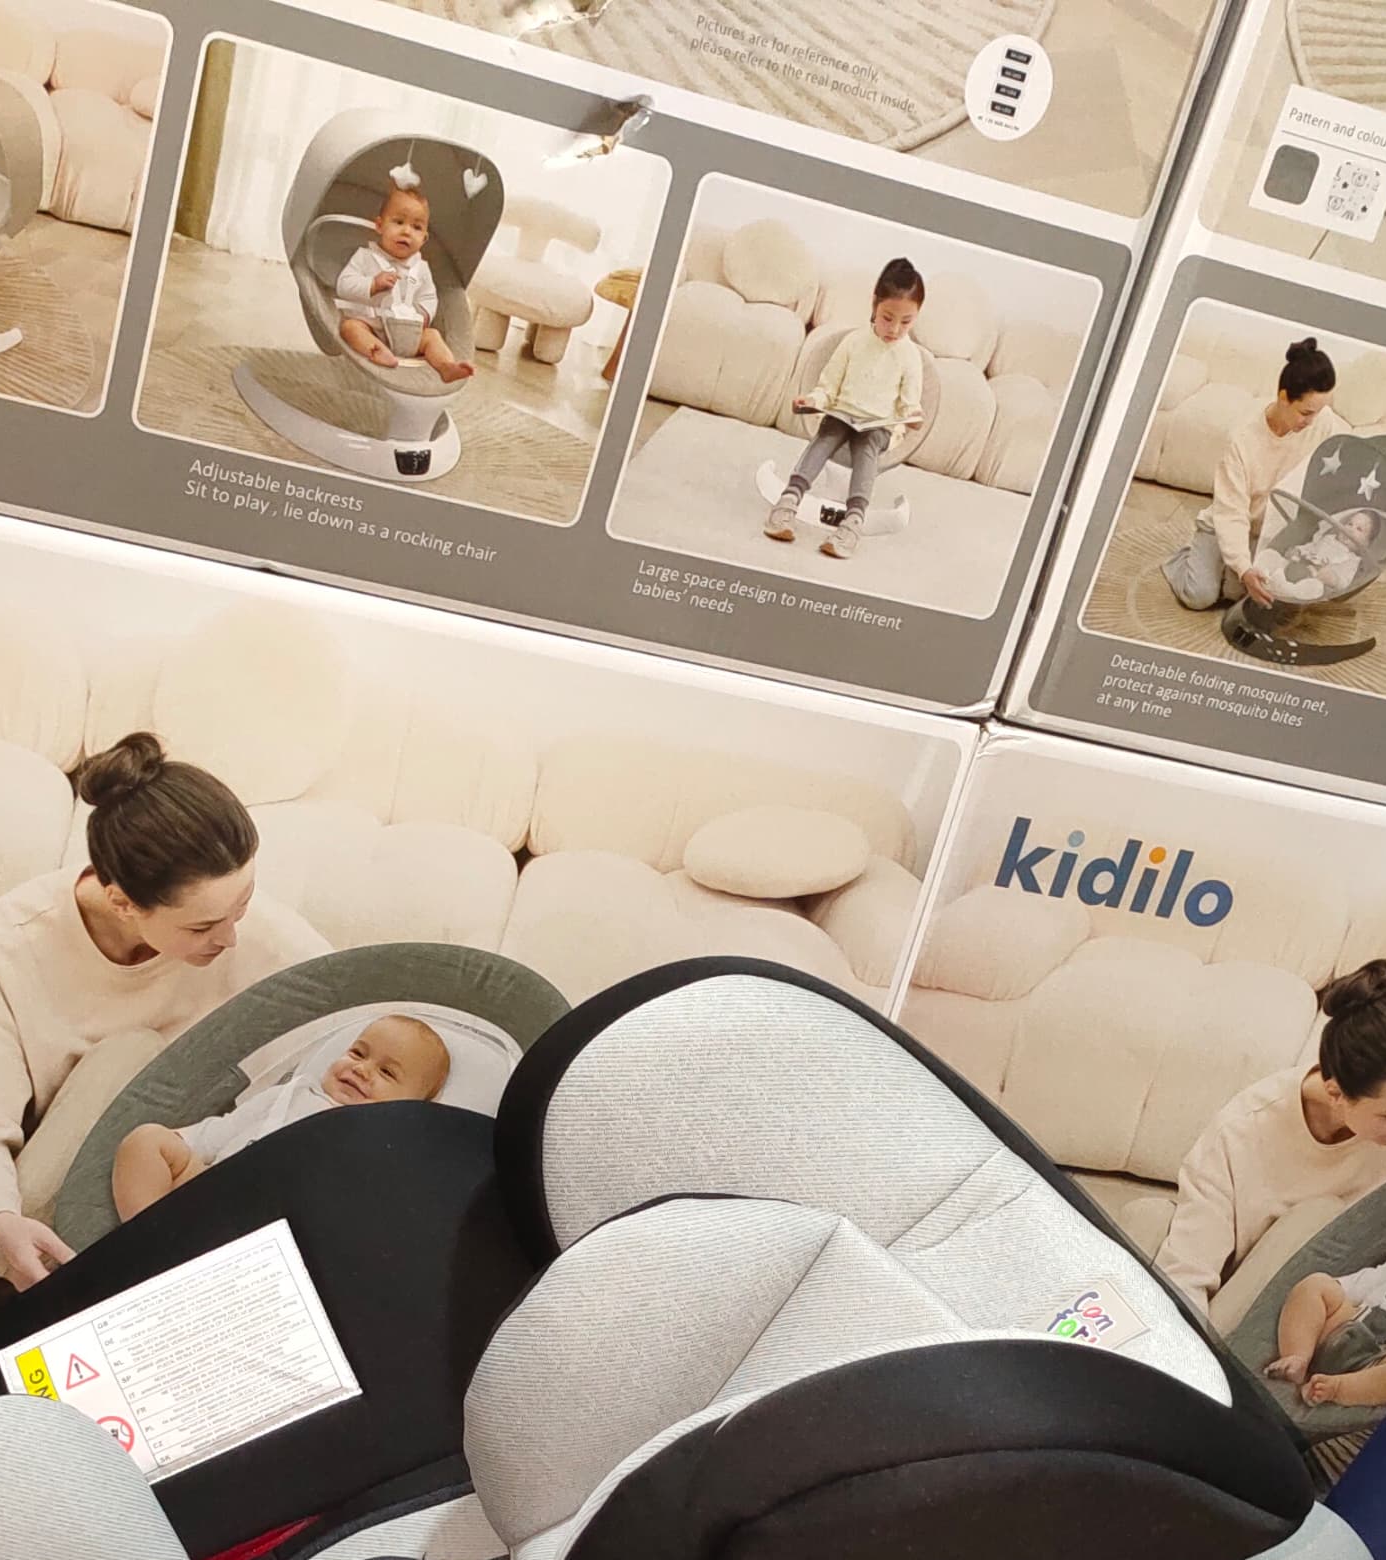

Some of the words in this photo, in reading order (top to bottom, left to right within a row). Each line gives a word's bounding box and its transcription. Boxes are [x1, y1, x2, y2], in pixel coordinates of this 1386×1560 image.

[690, 37, 732, 60] please
[734, 48, 764, 68] refer
[766, 59, 779, 73] to
[782, 62, 803, 80] the
[806, 71, 829, 87] real
[831, 77, 878, 102] product
[696, 14, 746, 42] Pictures
[748, 32, 769, 48] are
[772, 37, 790, 54] for
[791, 45, 850, 74] reference
[1289, 107, 1331, 130] Pattern
[1333, 122, 1356, 137] and
[189, 458, 280, 493] Adjustable
[285, 482, 363, 512] backrests
[185, 480, 207, 499] Sit
[212, 487, 230, 503] to
[283, 502, 303, 519] lie
[308, 508, 354, 532] down
[358, 521, 376, 536] as
[380, 526, 390, 539] a
[394, 530, 454, 555] rocking
[456, 541, 498, 563] chair
[638, 559, 680, 583] Large
[682, 571, 726, 596] space
[729, 579, 777, 605] design
[781, 592, 796, 607] to
[799, 598, 838, 617] meet
[840, 605, 904, 631] different
[690, 592, 735, 615] needs
[1096, 691, 1112, 705] at
[1113, 696, 1138, 716] any
[1141, 700, 1173, 719] time
[1102, 673, 1153, 696] protect
[1155, 684, 1206, 706] against
[1206, 695, 1269, 720] mosquito
[1271, 707, 1303, 728] bites
[1110, 653, 1188, 683] Detachable
[1189, 670, 1236, 695] folding
[1237, 685, 1301, 708] mosquito
[994, 816, 1233, 927] kidilo
